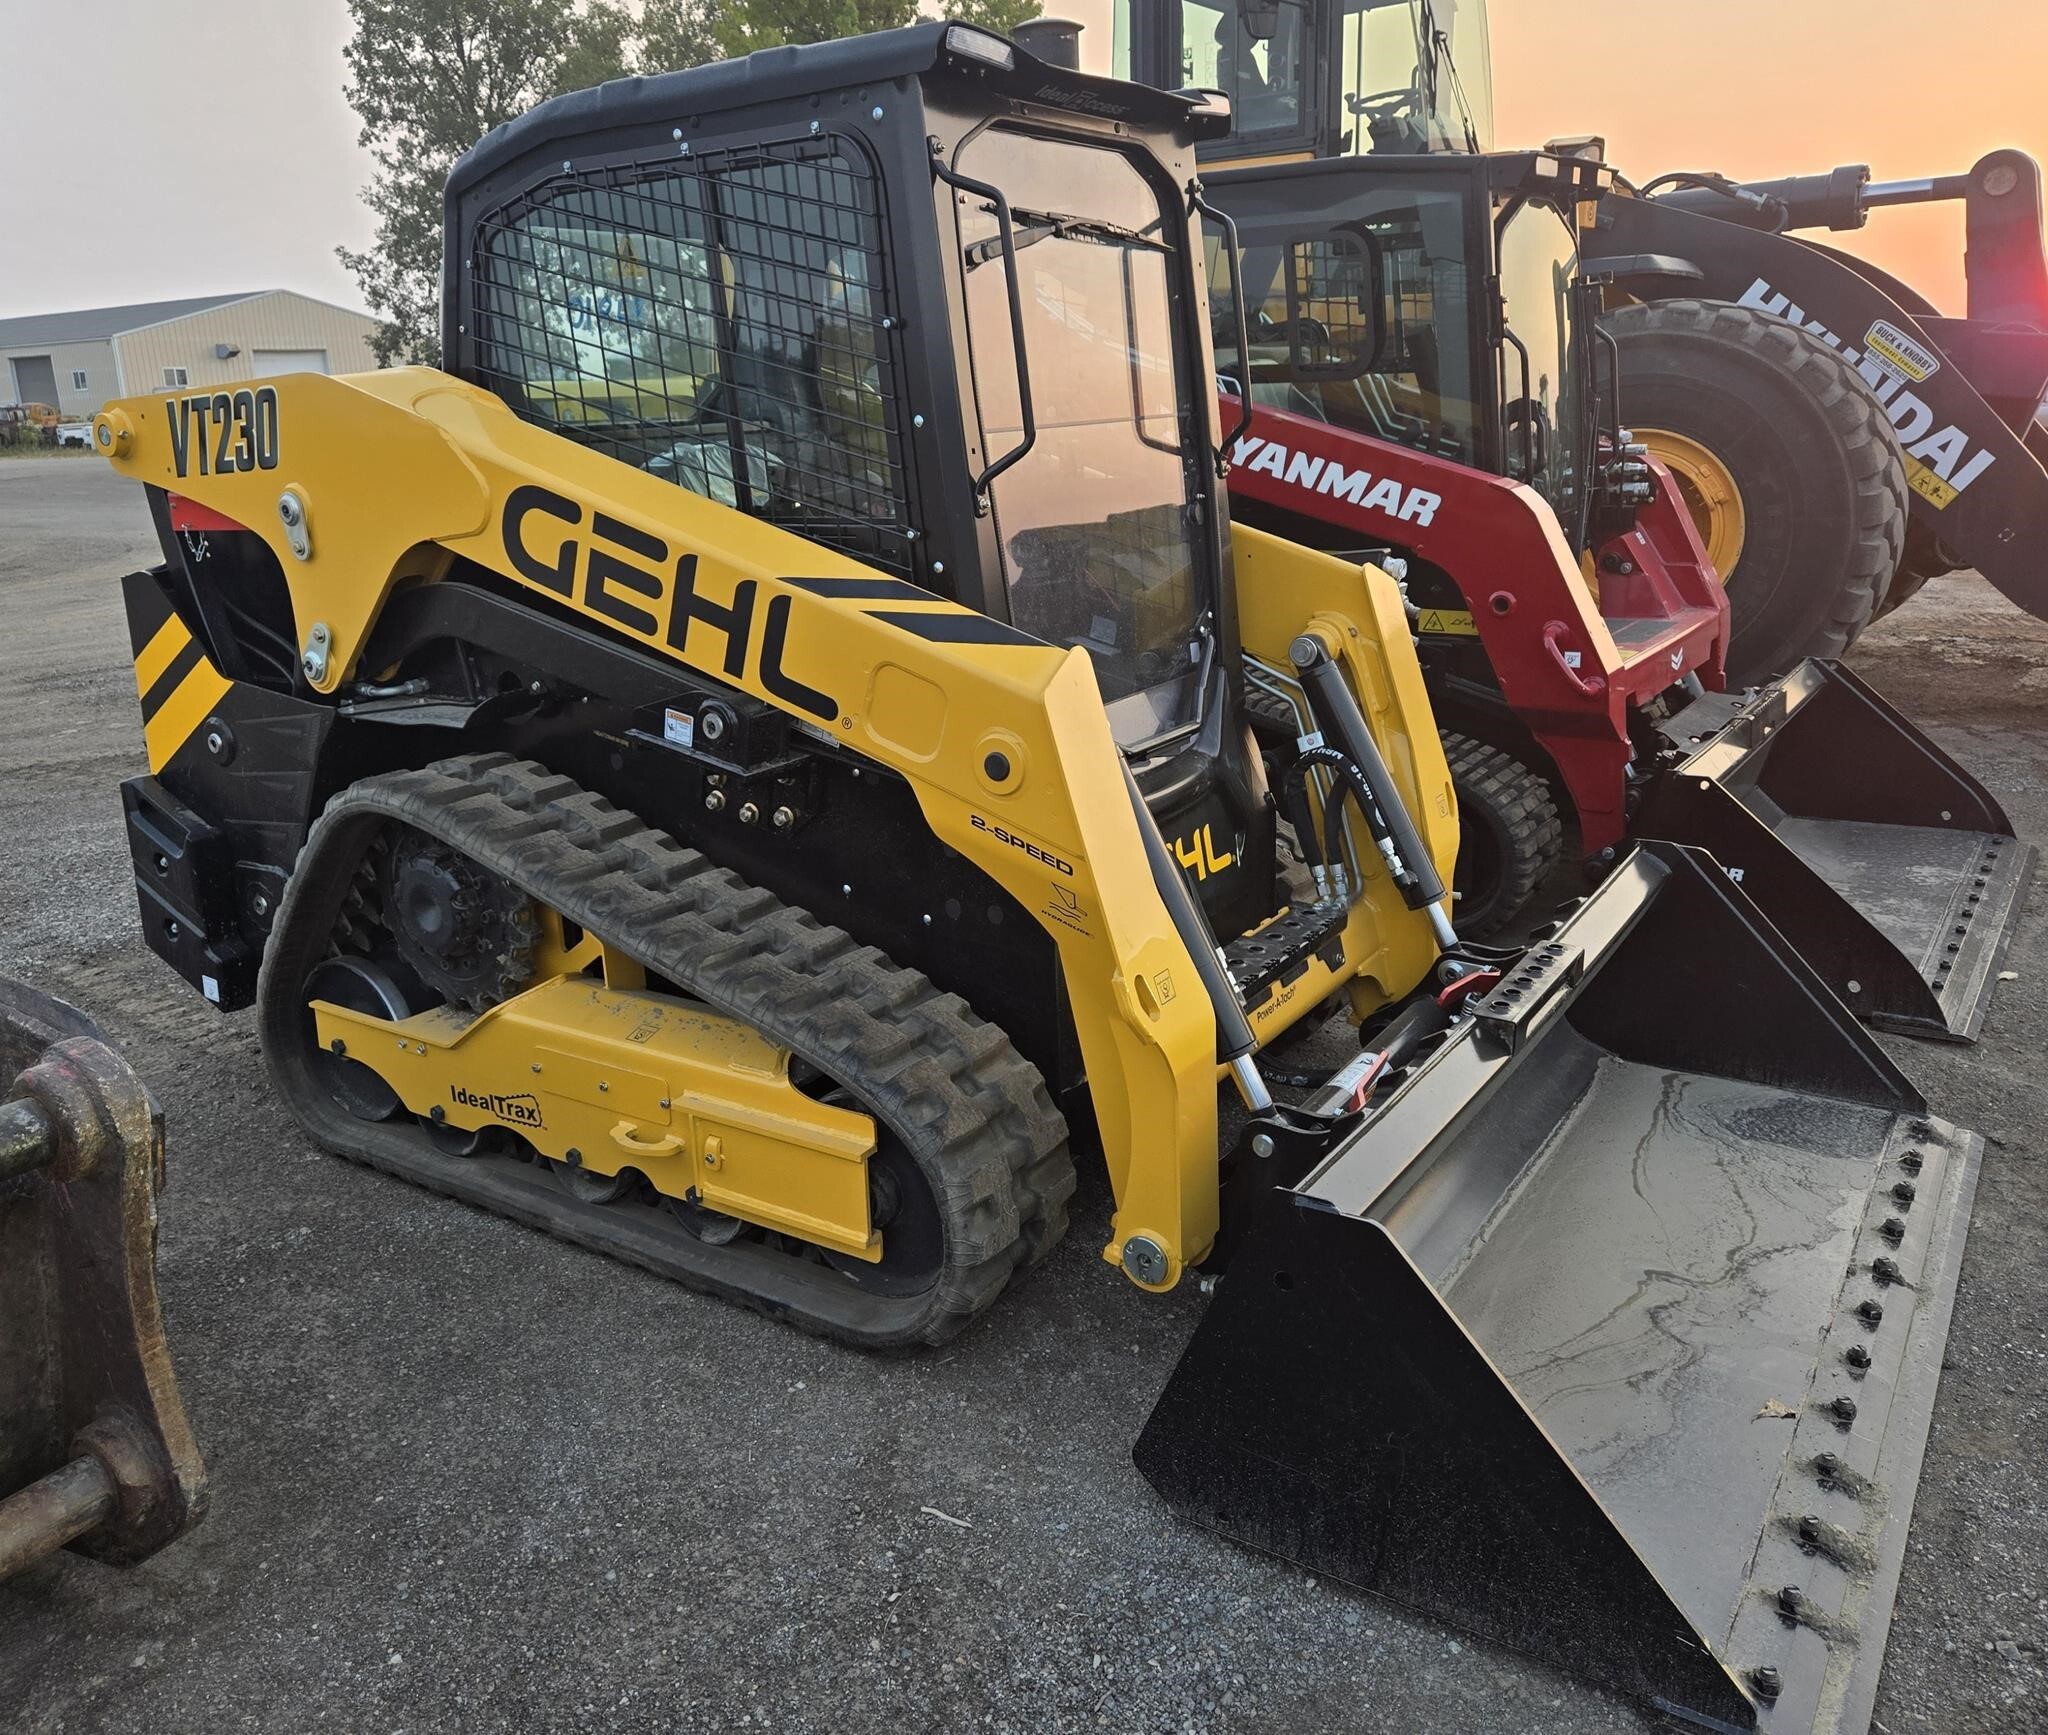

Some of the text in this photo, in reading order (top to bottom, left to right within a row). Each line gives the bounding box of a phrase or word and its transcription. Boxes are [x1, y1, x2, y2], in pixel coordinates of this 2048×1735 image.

[1736, 277, 1997, 494] HNDAI
[1875, 326, 1898, 347] BUCK
[1895, 342, 1903, 351] &
[1902, 345, 1934, 371] KNOBBY
[166, 385, 279, 479] VT230
[1231, 435, 1442, 528] YANMAR
[502, 484, 840, 722] GEHL
[970, 813, 1074, 877] 2-SPEED
[1165, 823, 1232, 882] HL
[450, 1084, 539, 1123] IdealTrax
